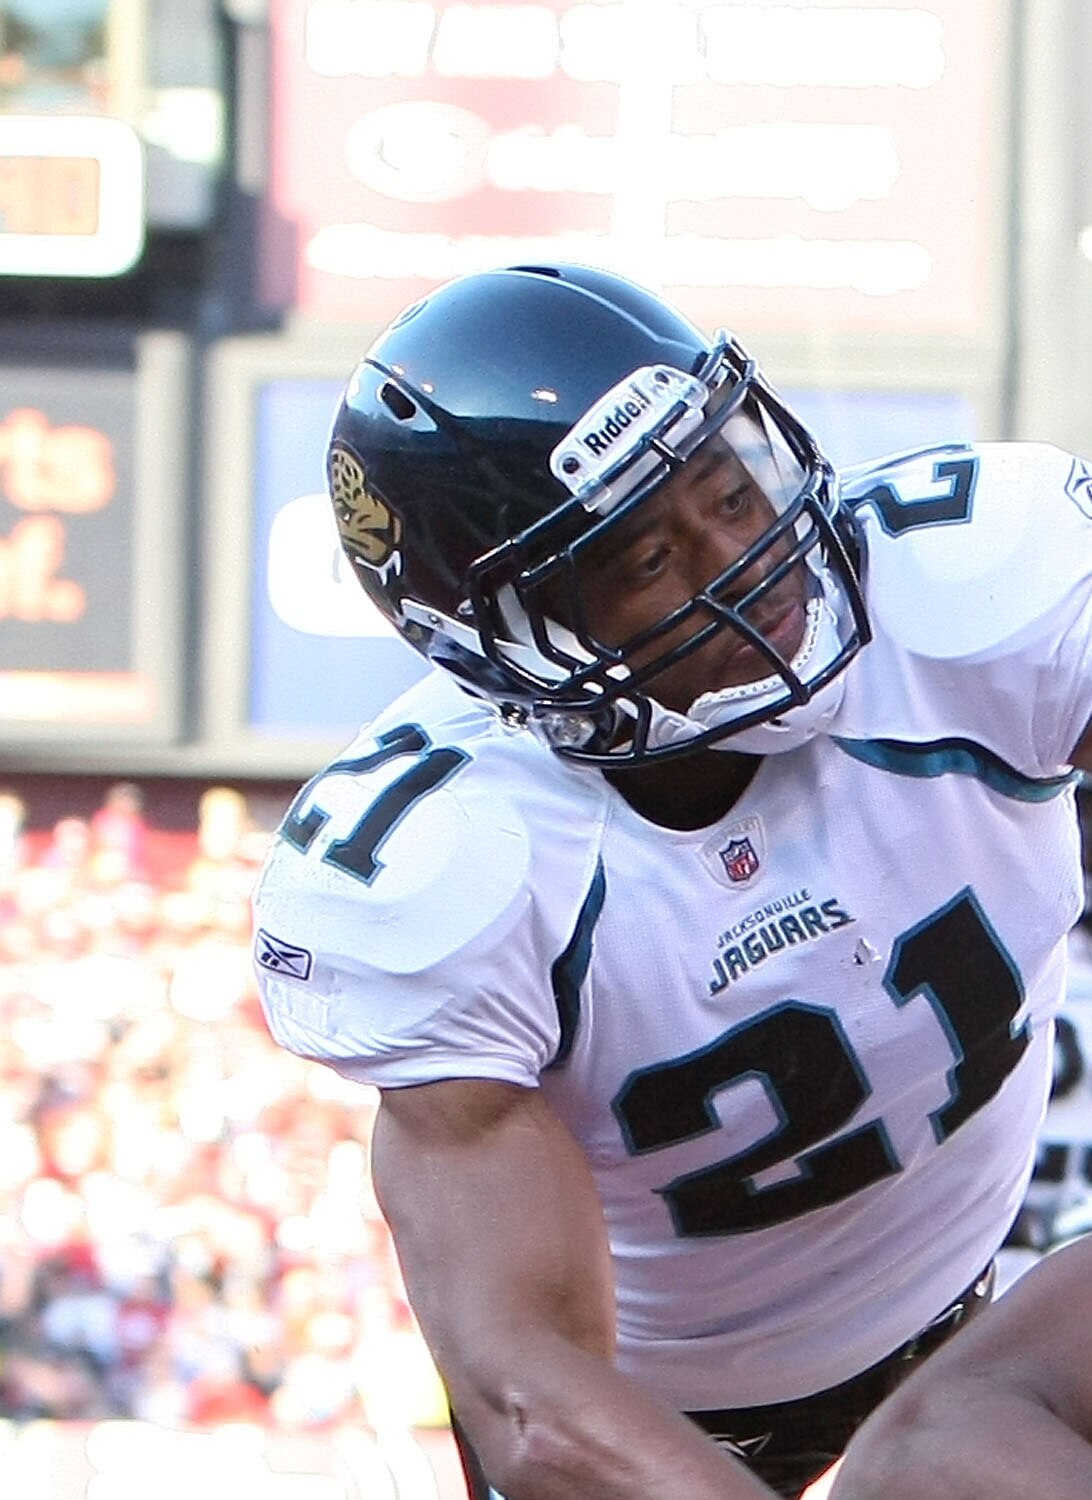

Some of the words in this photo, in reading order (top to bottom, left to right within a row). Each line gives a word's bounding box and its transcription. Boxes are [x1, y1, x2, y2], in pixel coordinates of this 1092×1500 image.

[583, 382, 652, 456] Riddell
[279, 722, 474, 888] 21
[709, 898, 857, 997] JAGUARS
[717, 888, 813, 949] JACKSONVILLE
[610, 884, 1034, 1238] 21
